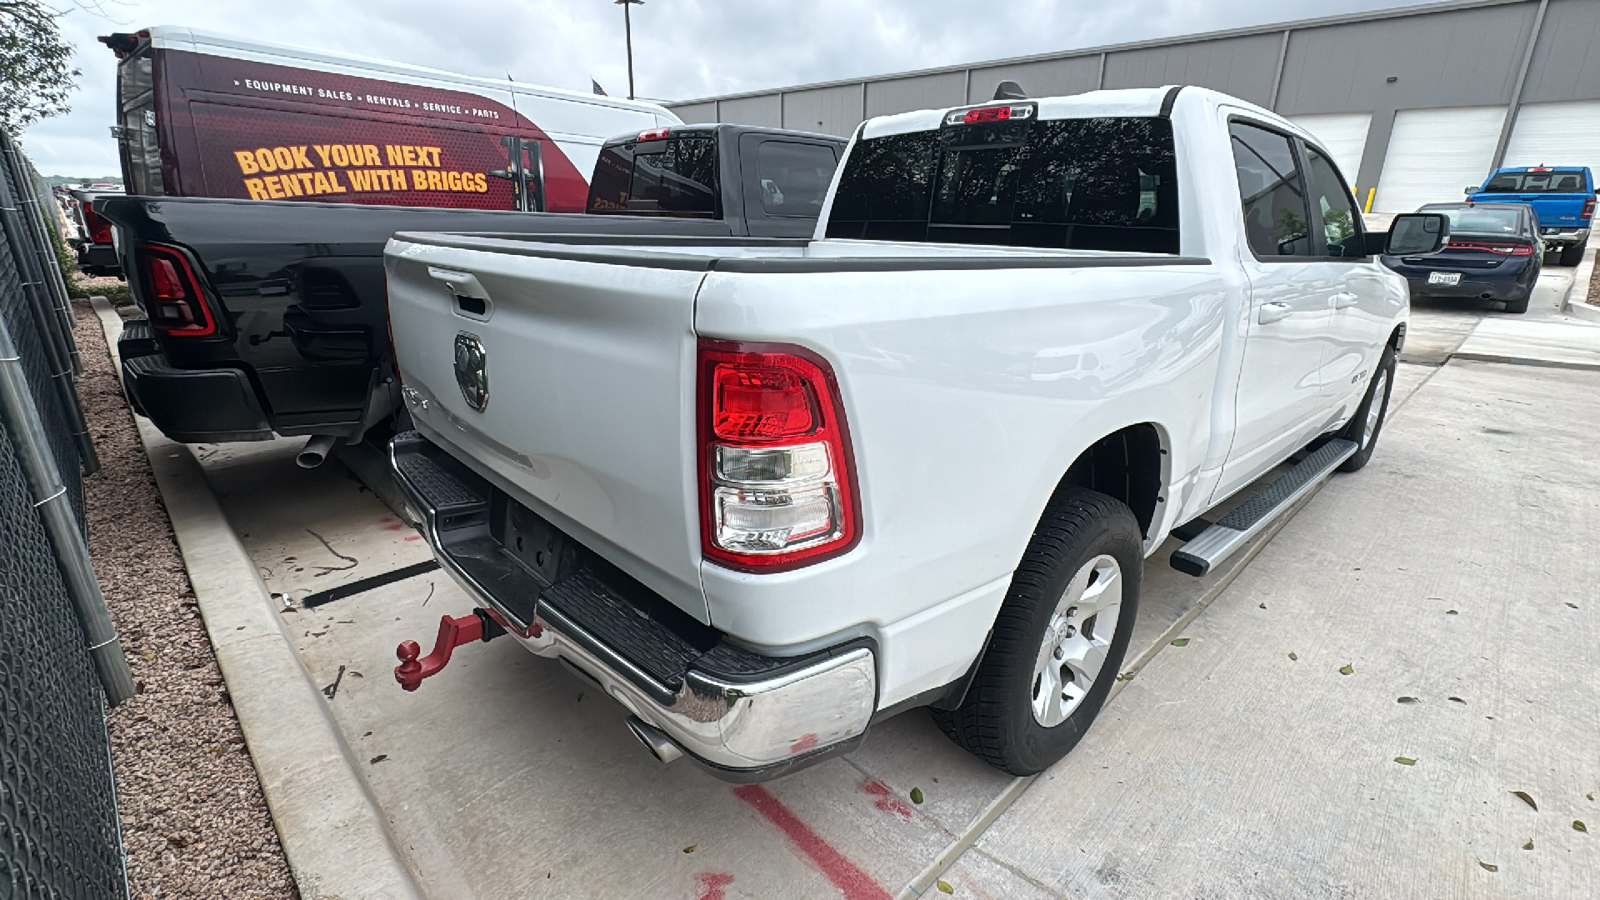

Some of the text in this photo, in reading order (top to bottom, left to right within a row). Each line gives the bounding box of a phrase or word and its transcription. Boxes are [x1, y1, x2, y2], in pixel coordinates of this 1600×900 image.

[245, 79, 500, 119] EQUIPMENT SALES RENTALS SERVICE PARTS
[234, 145, 442, 174] BOOK YOUR NEXT
[244, 169, 488, 200] RENTAL WITH BRIGGS
